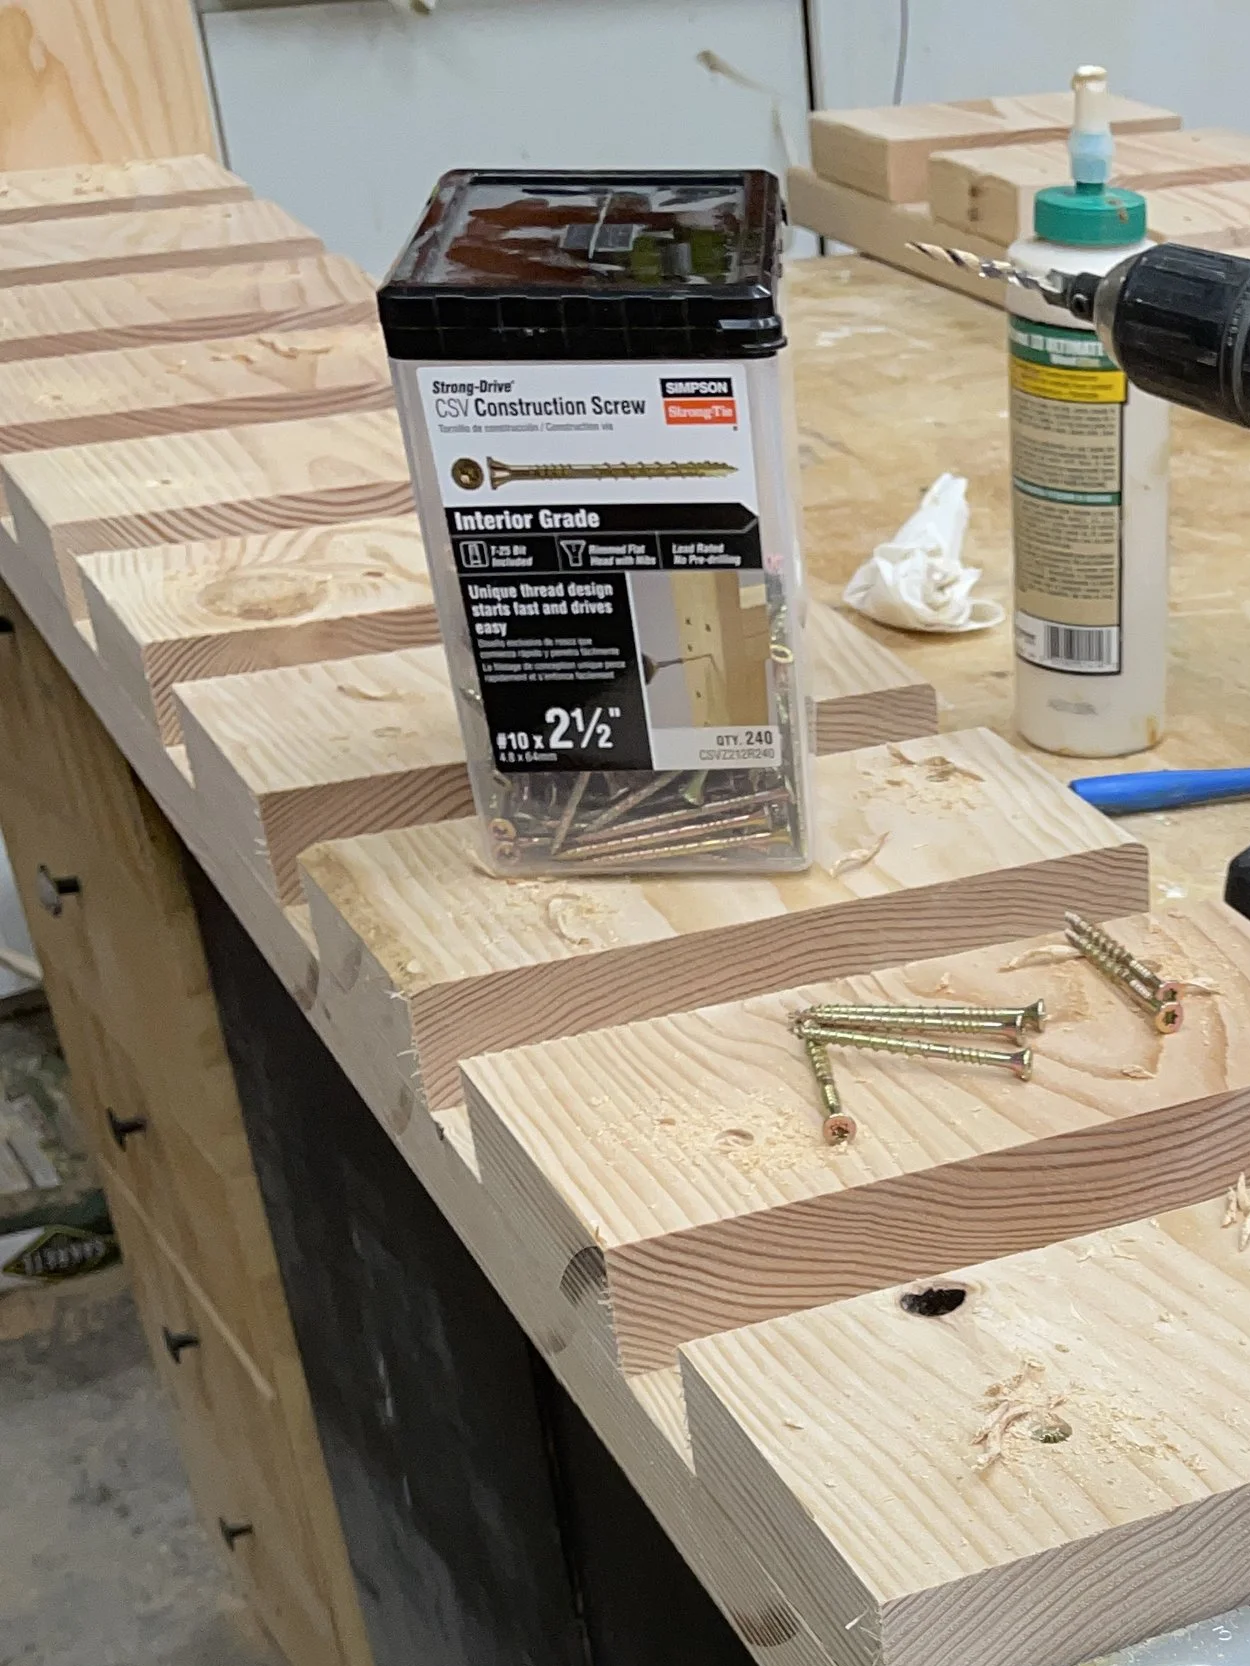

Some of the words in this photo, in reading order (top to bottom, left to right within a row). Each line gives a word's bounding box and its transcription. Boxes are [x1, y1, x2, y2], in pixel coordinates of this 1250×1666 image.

[665, 382, 728, 394] SIMPSON
[435, 398, 470, 418] CSV
[474, 396, 587, 416] Construction
[591, 395, 646, 415] Screw
[454, 511, 533, 531] Interior
[539, 509, 600, 528] Grade
[467, 583, 518, 600] Unique
[519, 582, 565, 598] thread
[567, 581, 614, 599] design
[471, 602, 511, 617] starts
[513, 601, 540, 616] fast
[542, 600, 568, 615] and
[570, 599, 613, 615] drives
[475, 622, 508, 637] easy
[496, 732, 529, 750] #10
[533, 736, 545, 750] x
[746, 730, 773, 745] 240
